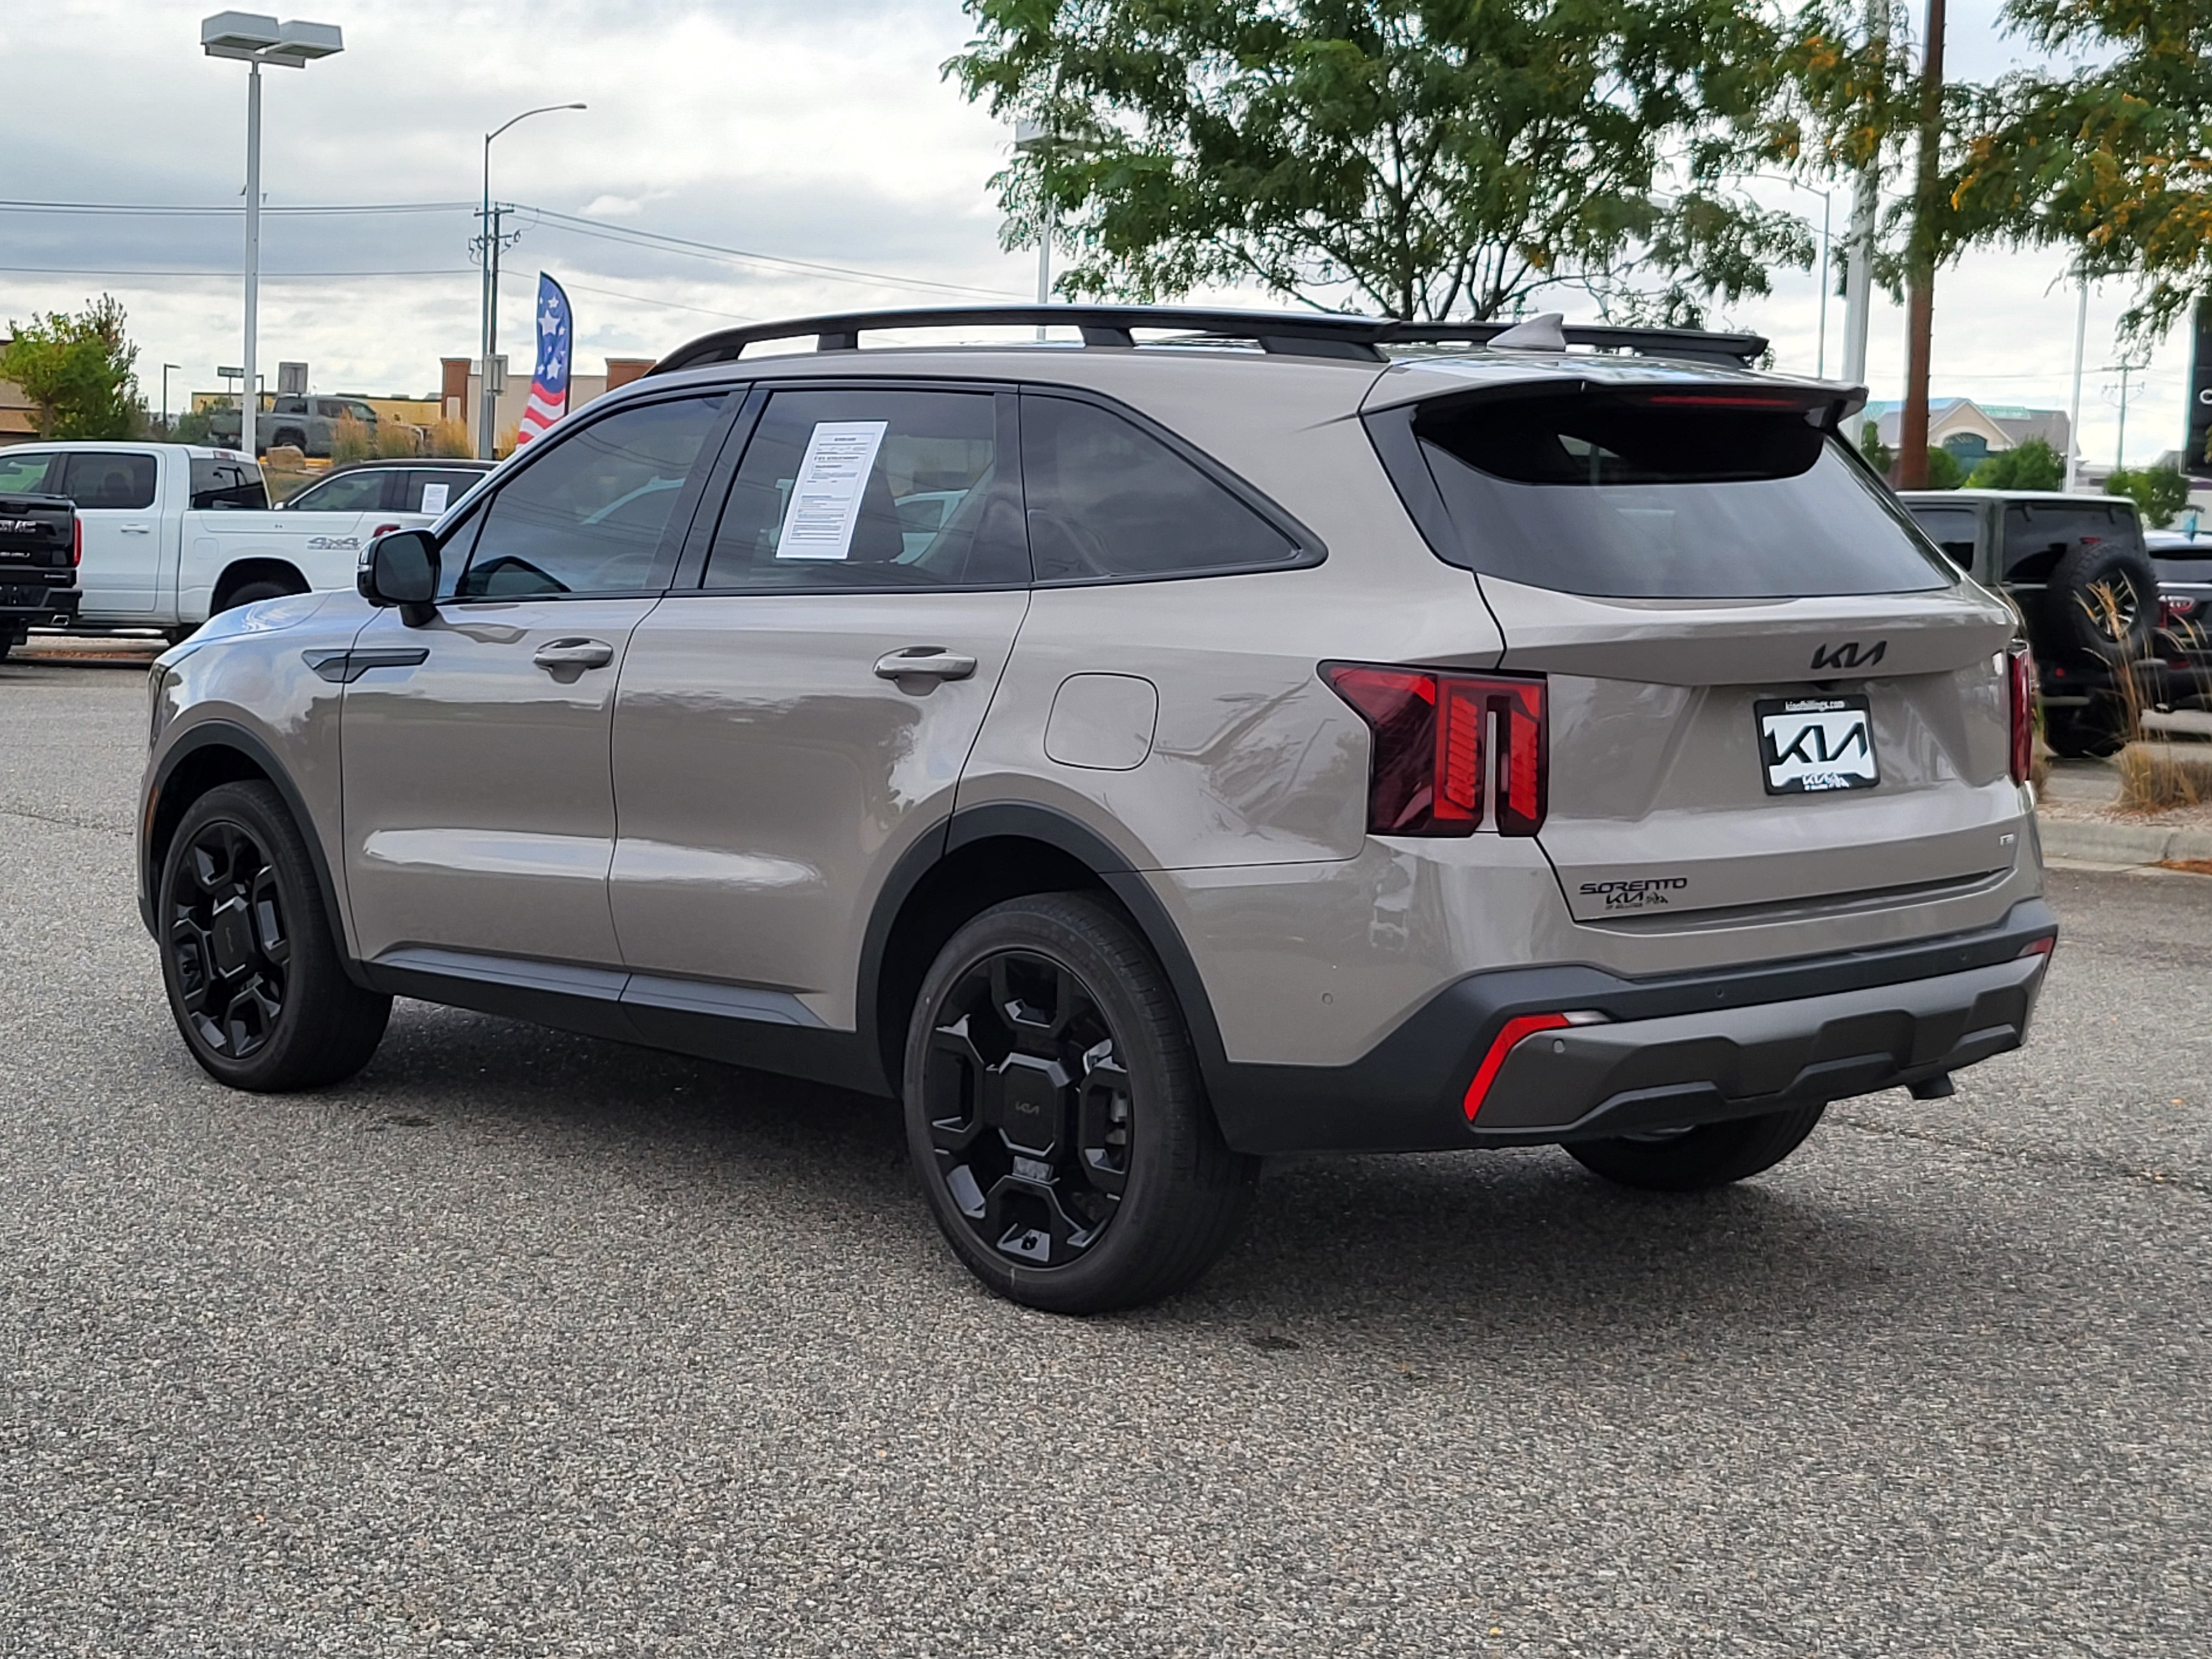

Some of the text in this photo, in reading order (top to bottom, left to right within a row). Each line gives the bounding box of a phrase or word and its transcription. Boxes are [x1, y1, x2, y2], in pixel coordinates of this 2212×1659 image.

[1810, 640, 1887, 669] KIA
[1765, 721, 1868, 766] KIA
[1579, 878, 1688, 895] SORENTO
[1606, 891, 1644, 904] KIA
